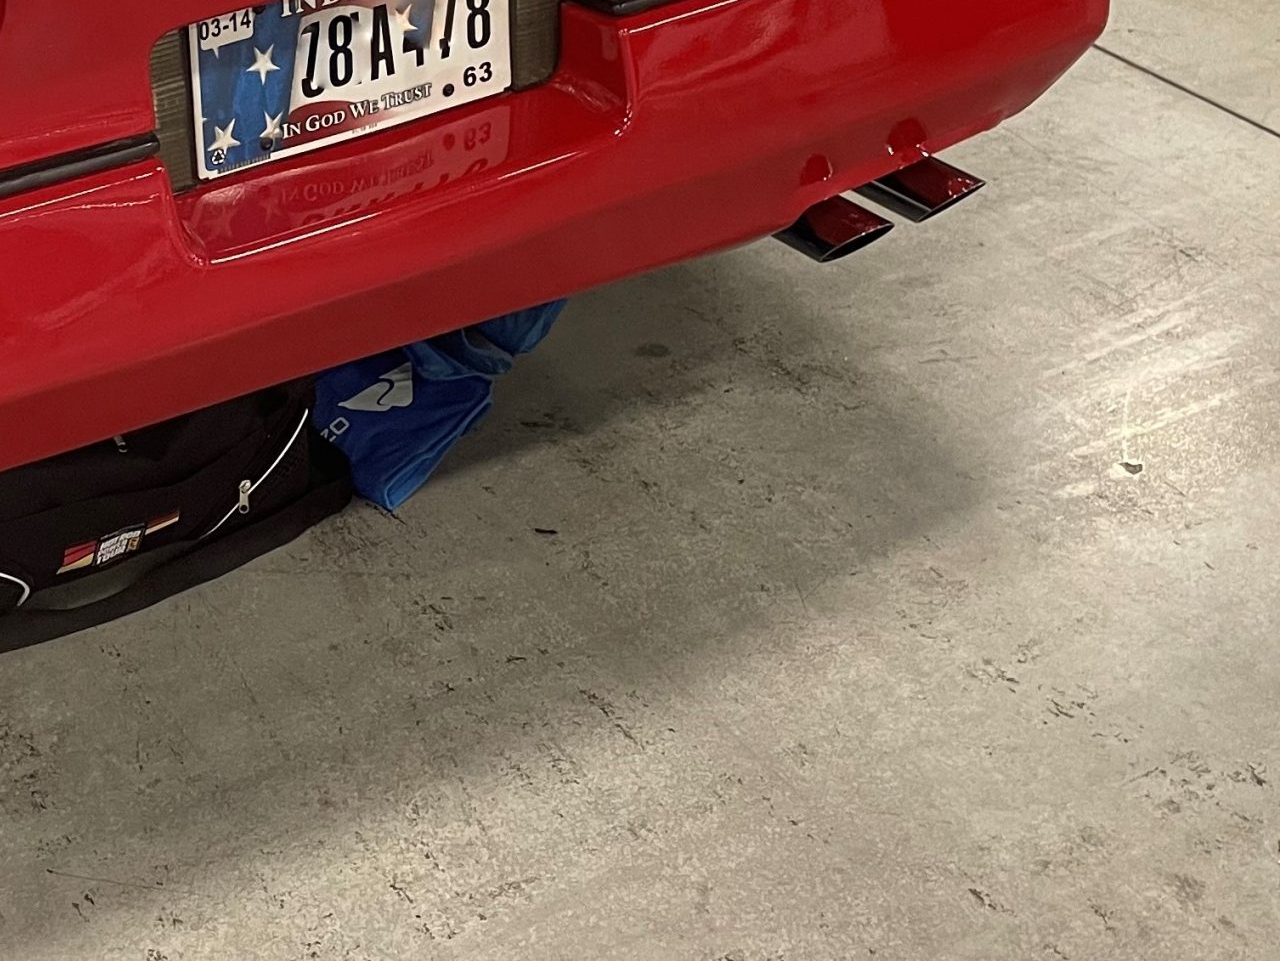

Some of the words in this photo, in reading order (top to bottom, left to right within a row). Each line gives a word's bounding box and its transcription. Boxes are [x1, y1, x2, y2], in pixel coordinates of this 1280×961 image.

[199, 10, 252, 41] 03-14
[463, 61, 493, 87] 63
[281, 122, 301, 139] IN
[305, 109, 346, 133] GOD
[349, 98, 379, 120] WE
[381, 82, 432, 110] TRUST
